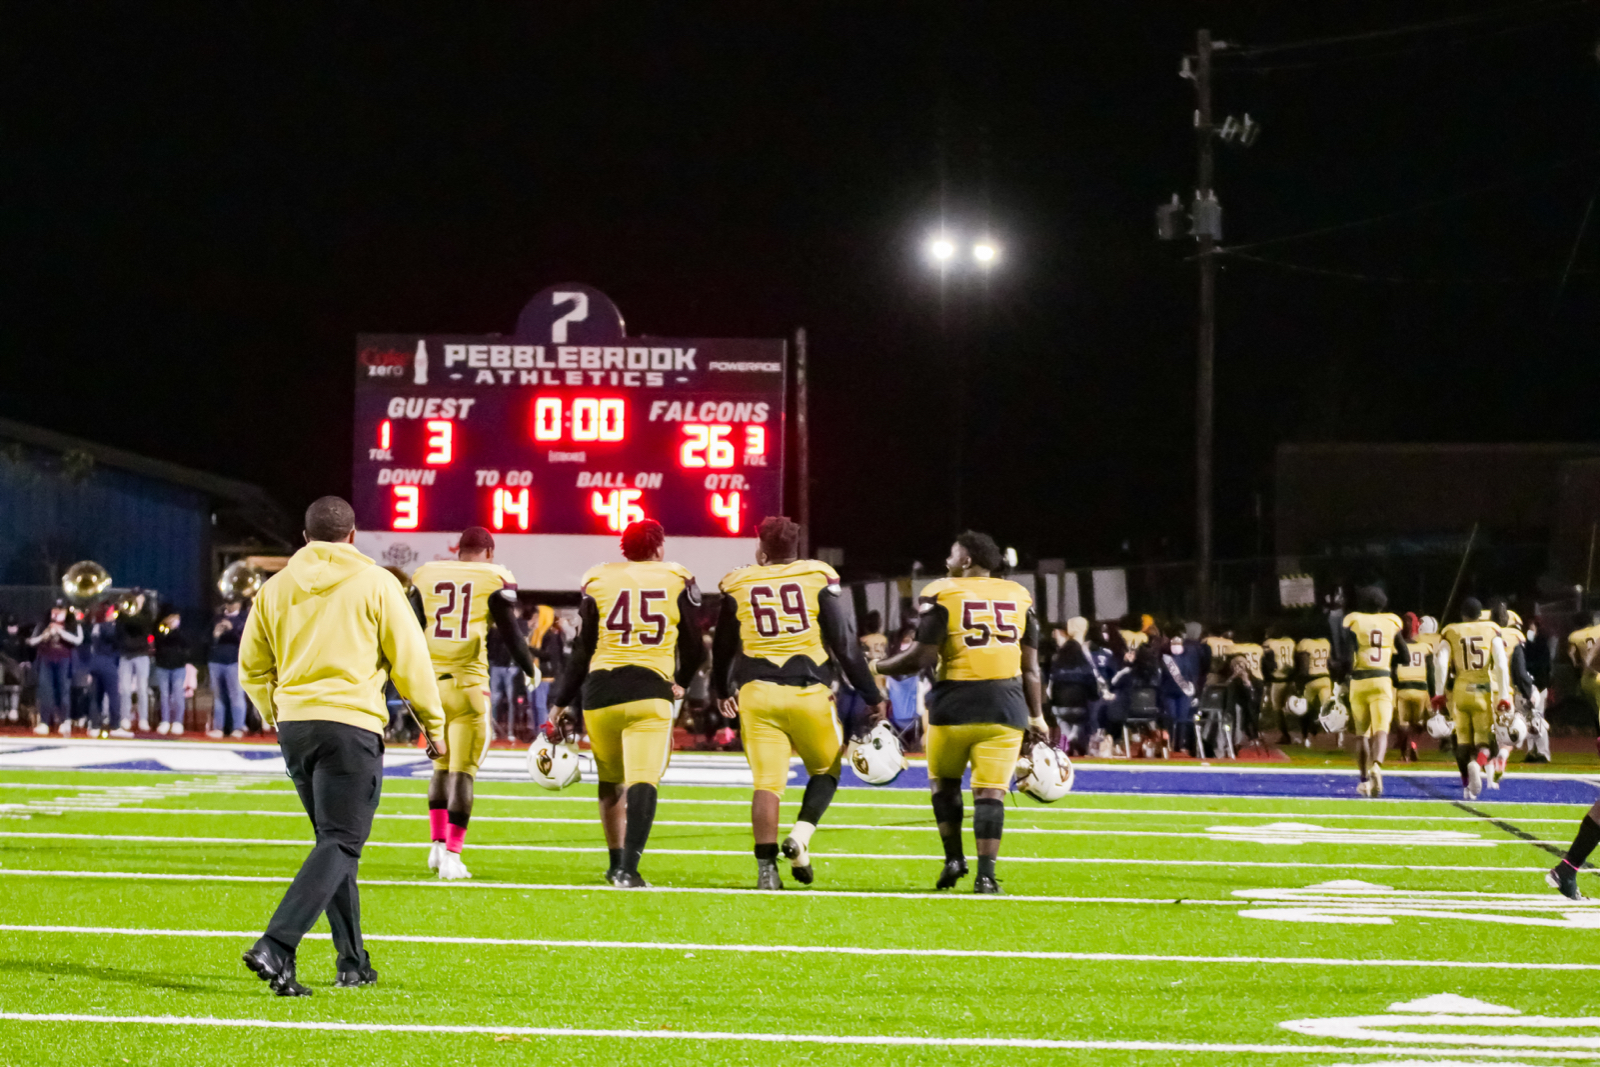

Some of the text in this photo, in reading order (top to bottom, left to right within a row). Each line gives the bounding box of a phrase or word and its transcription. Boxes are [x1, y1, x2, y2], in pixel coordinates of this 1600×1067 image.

[368, 365, 404, 377] zero
[444, 344, 697, 371] PEBBLEBROOK
[475, 369, 664, 387] ATHLETICS
[387, 396, 475, 420] GUEST
[534, 397, 625, 441] 0:00
[649, 400, 770, 422] FALCONS
[426, 420, 452, 464] 3
[681, 424, 735, 467] 26
[745, 425, 765, 455] 3
[377, 468, 437, 486] DOWN
[475, 469, 534, 487] TO GO
[576, 471, 664, 490] BALL ON
[704, 474, 751, 491] QTR.
[393, 485, 419, 529] 3
[493, 487, 530, 531] 14
[591, 489, 645, 532] 46
[711, 491, 741, 534] 4
[432, 580, 475, 642] 21
[604, 588, 668, 647] 45
[749, 582, 811, 638] 69
[960, 600, 1019, 649] 55
[1369, 629, 1384, 664] 9
[1459, 636, 1485, 671] 15
